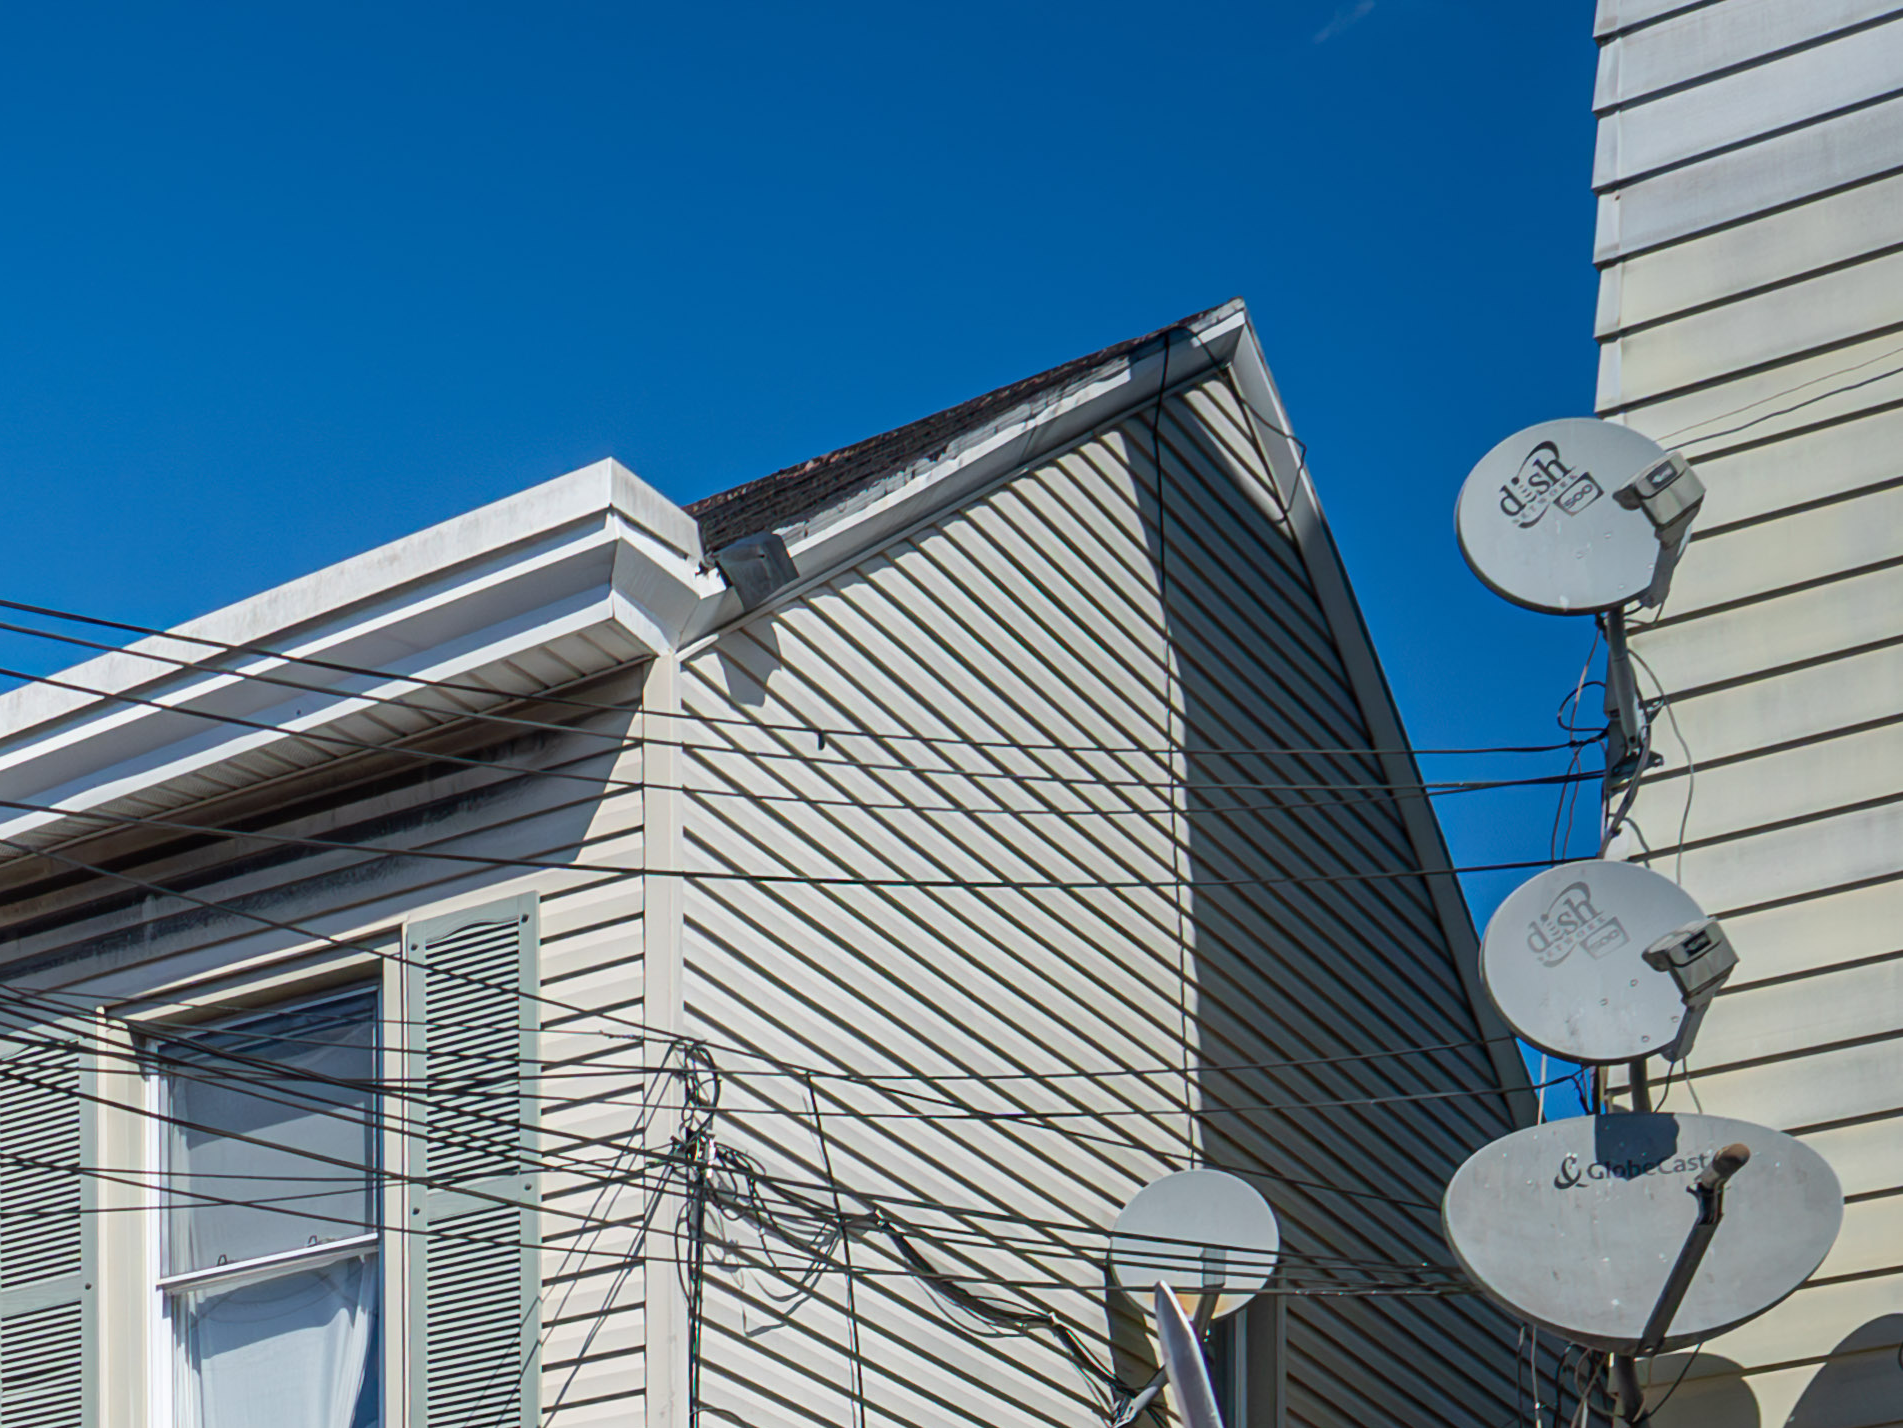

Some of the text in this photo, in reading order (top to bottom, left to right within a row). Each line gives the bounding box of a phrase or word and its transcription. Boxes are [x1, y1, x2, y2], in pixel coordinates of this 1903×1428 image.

[1499, 457, 1577, 517] dish
[1527, 897, 1604, 954] dish
[1586, 1152, 1711, 1180] GlobeCast
